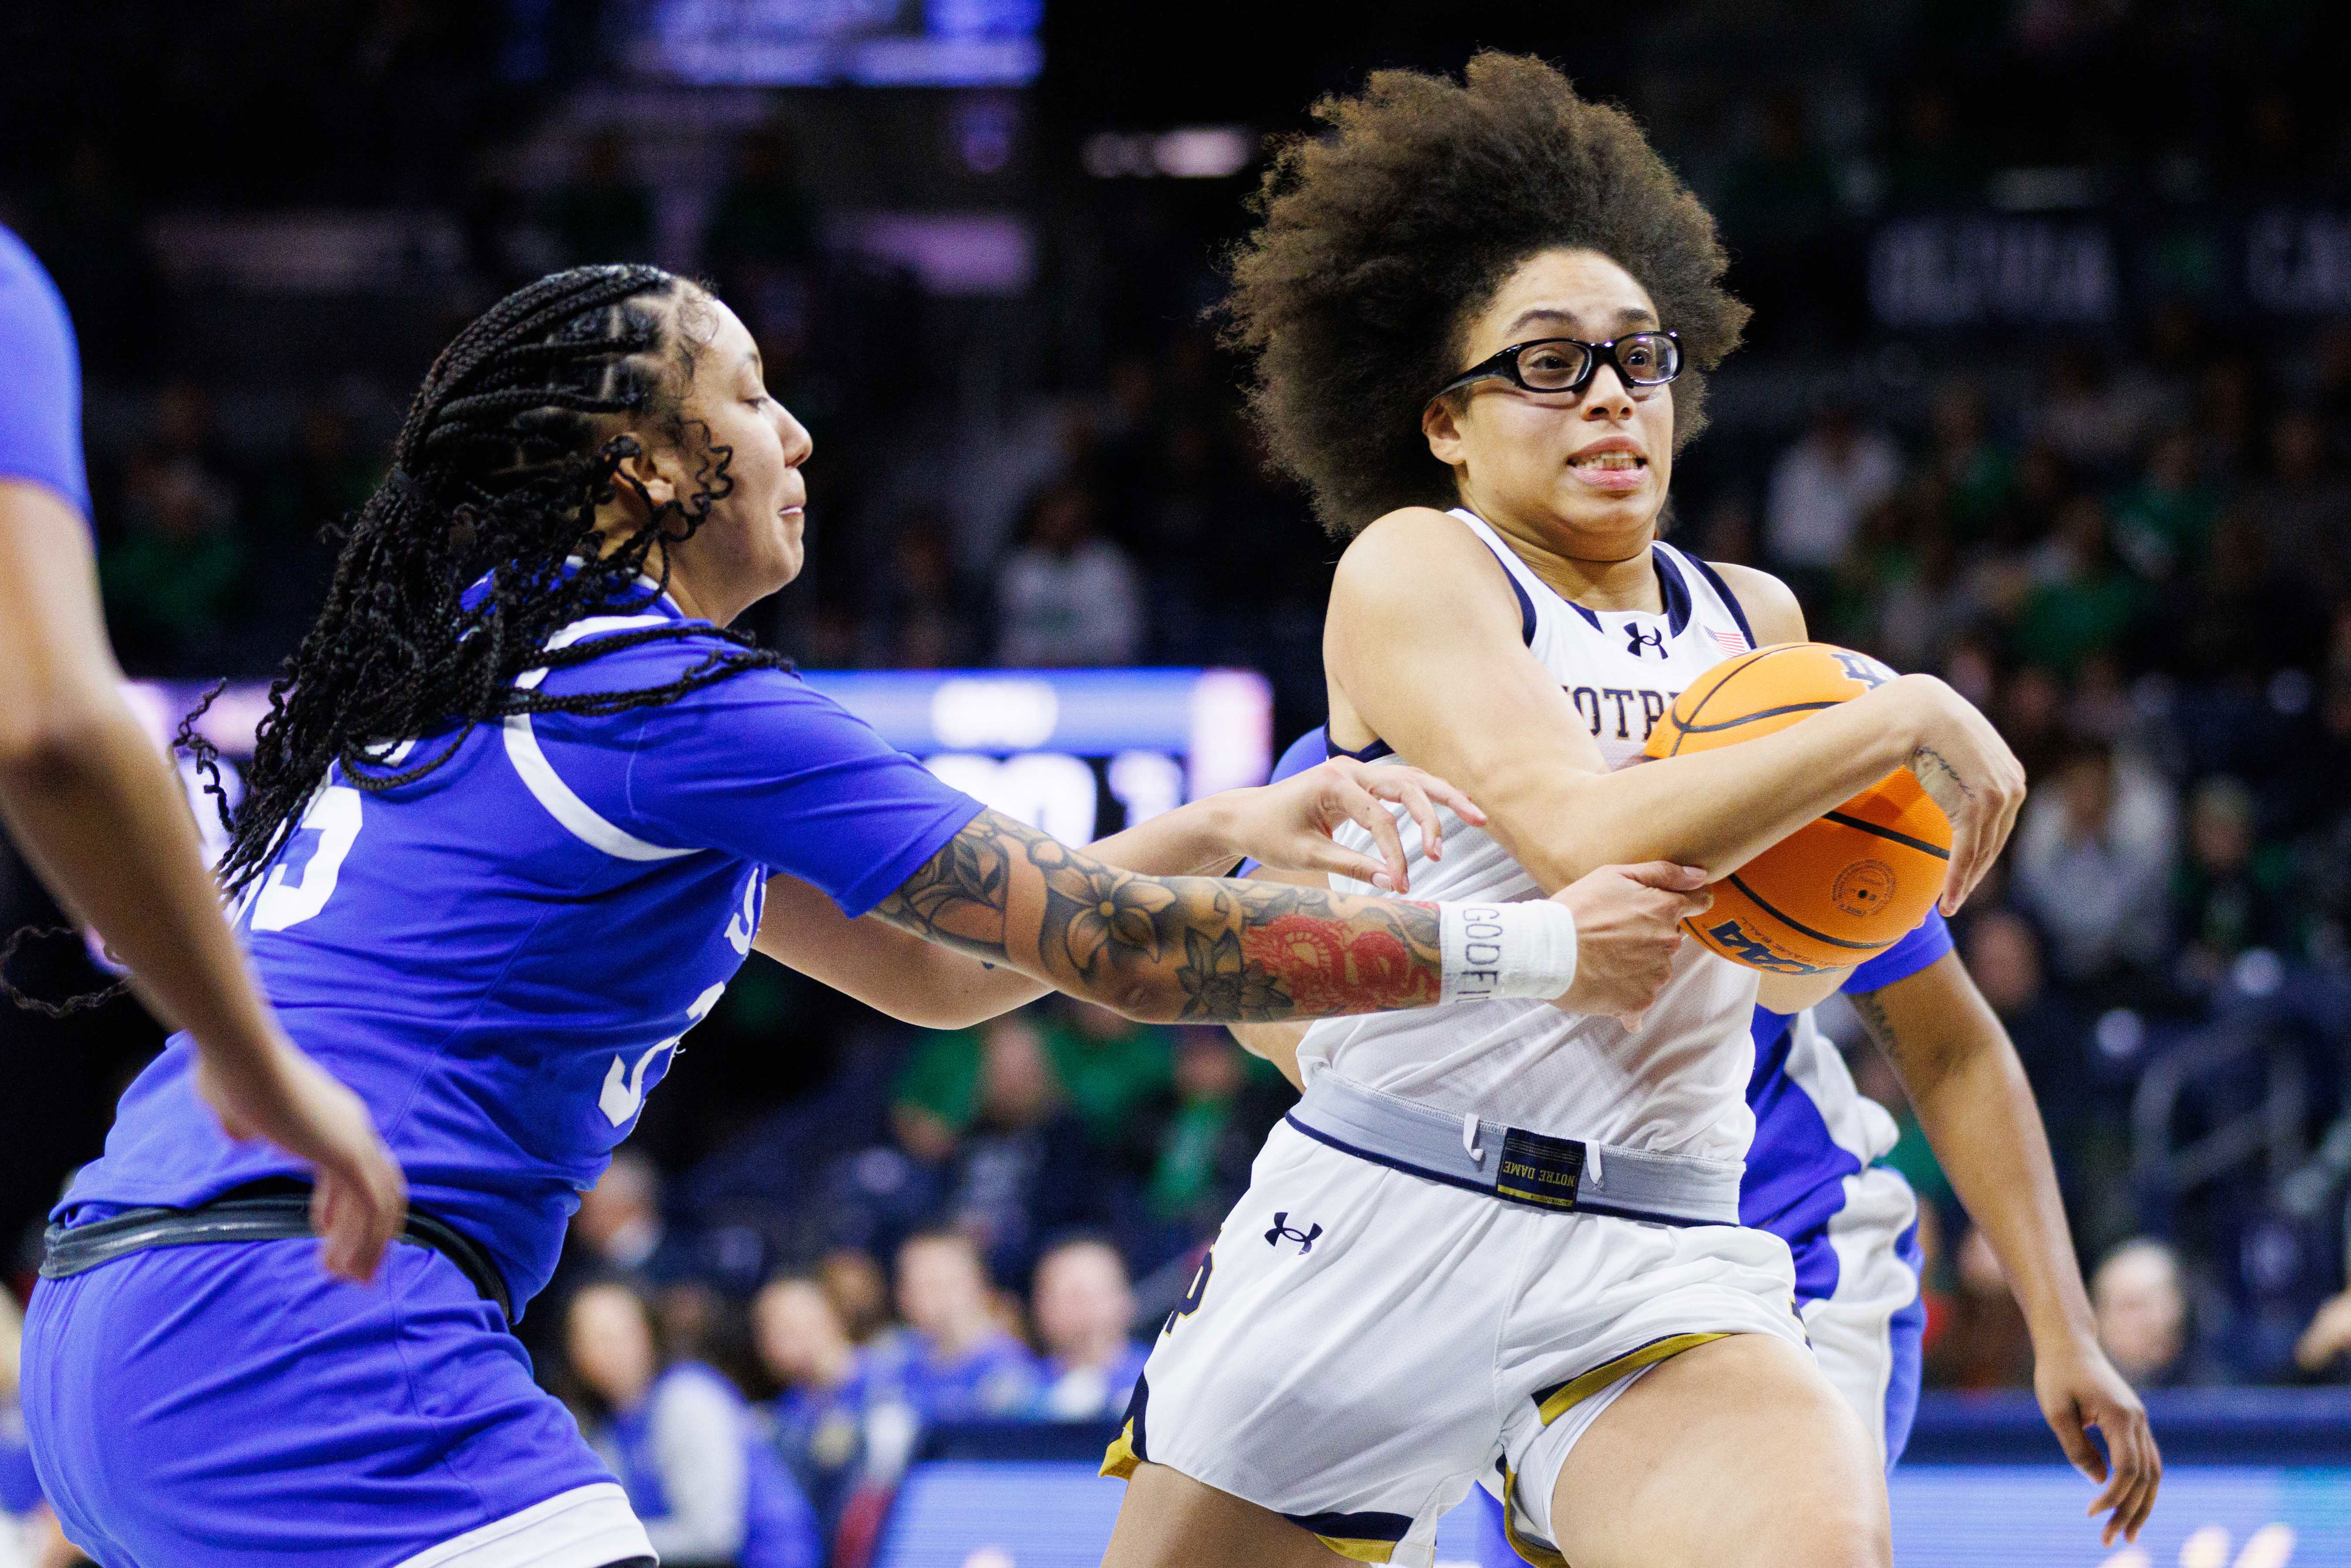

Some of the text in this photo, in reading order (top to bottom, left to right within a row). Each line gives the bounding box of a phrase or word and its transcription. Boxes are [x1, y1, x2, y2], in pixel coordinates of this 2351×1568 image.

[1561, 685, 1681, 742] OTR
[1502, 1161, 1576, 1187] NOTRE DAME
